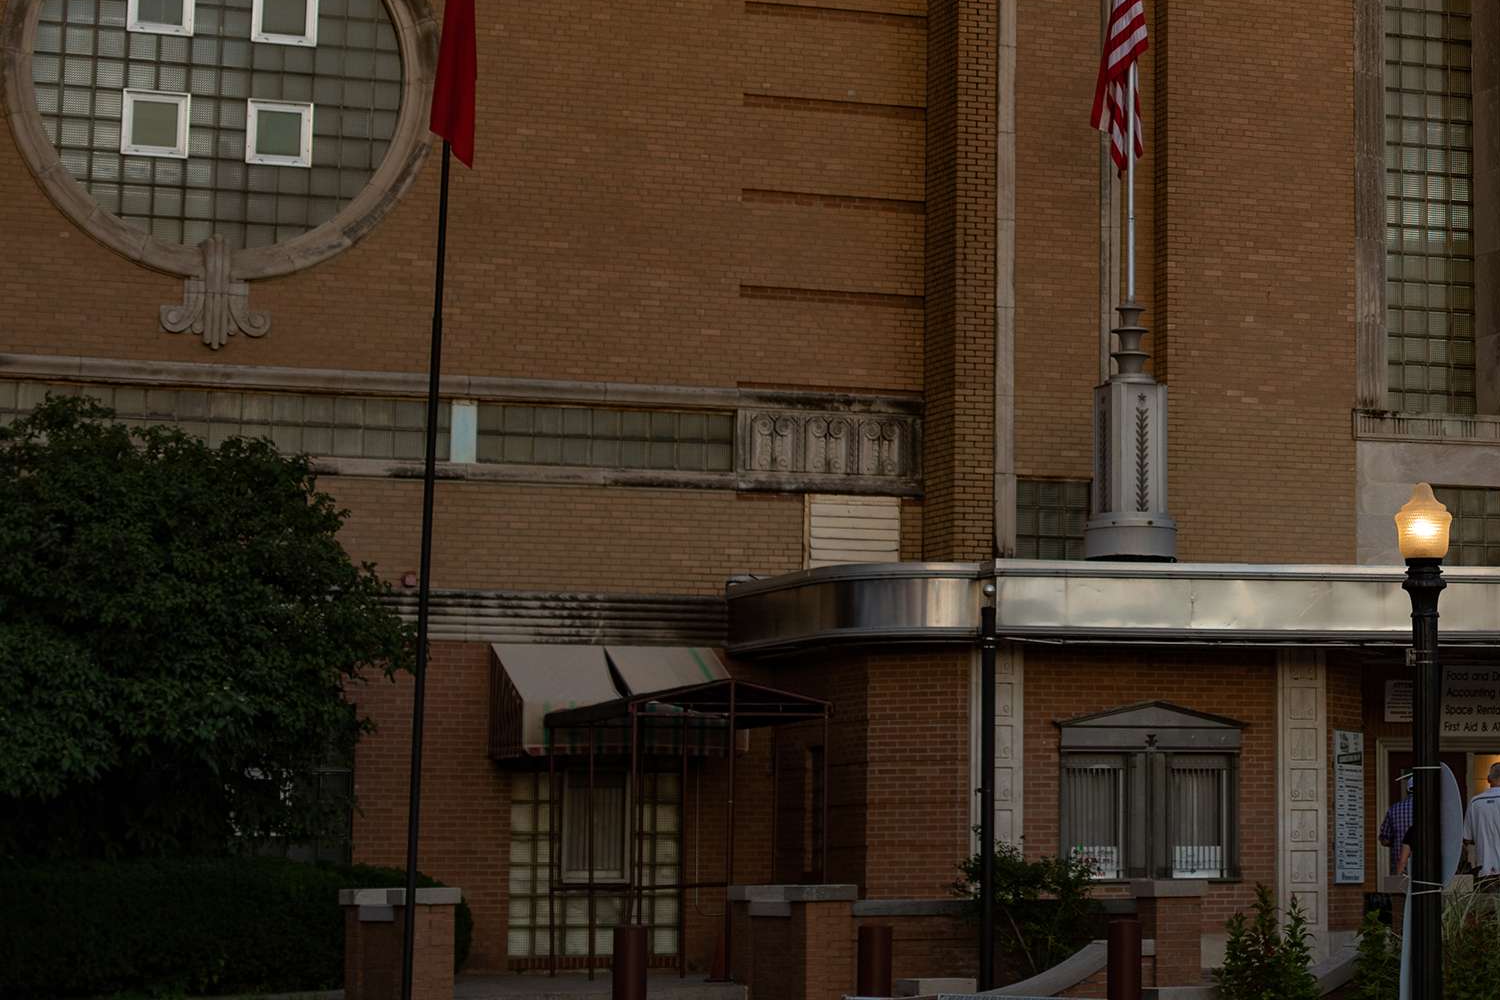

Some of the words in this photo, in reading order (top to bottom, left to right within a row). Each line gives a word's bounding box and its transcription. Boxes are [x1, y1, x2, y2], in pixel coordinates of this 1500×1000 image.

[1447, 671, 1468, 681] Food
[1472, 671, 1489, 681] and
[1446, 687, 1496, 699] Accounting
[1445, 704, 1474, 716] Space
[1444, 721, 1460, 732] First
[1464, 721, 1478, 732] Aid
[1481, 722, 1489, 732] &
